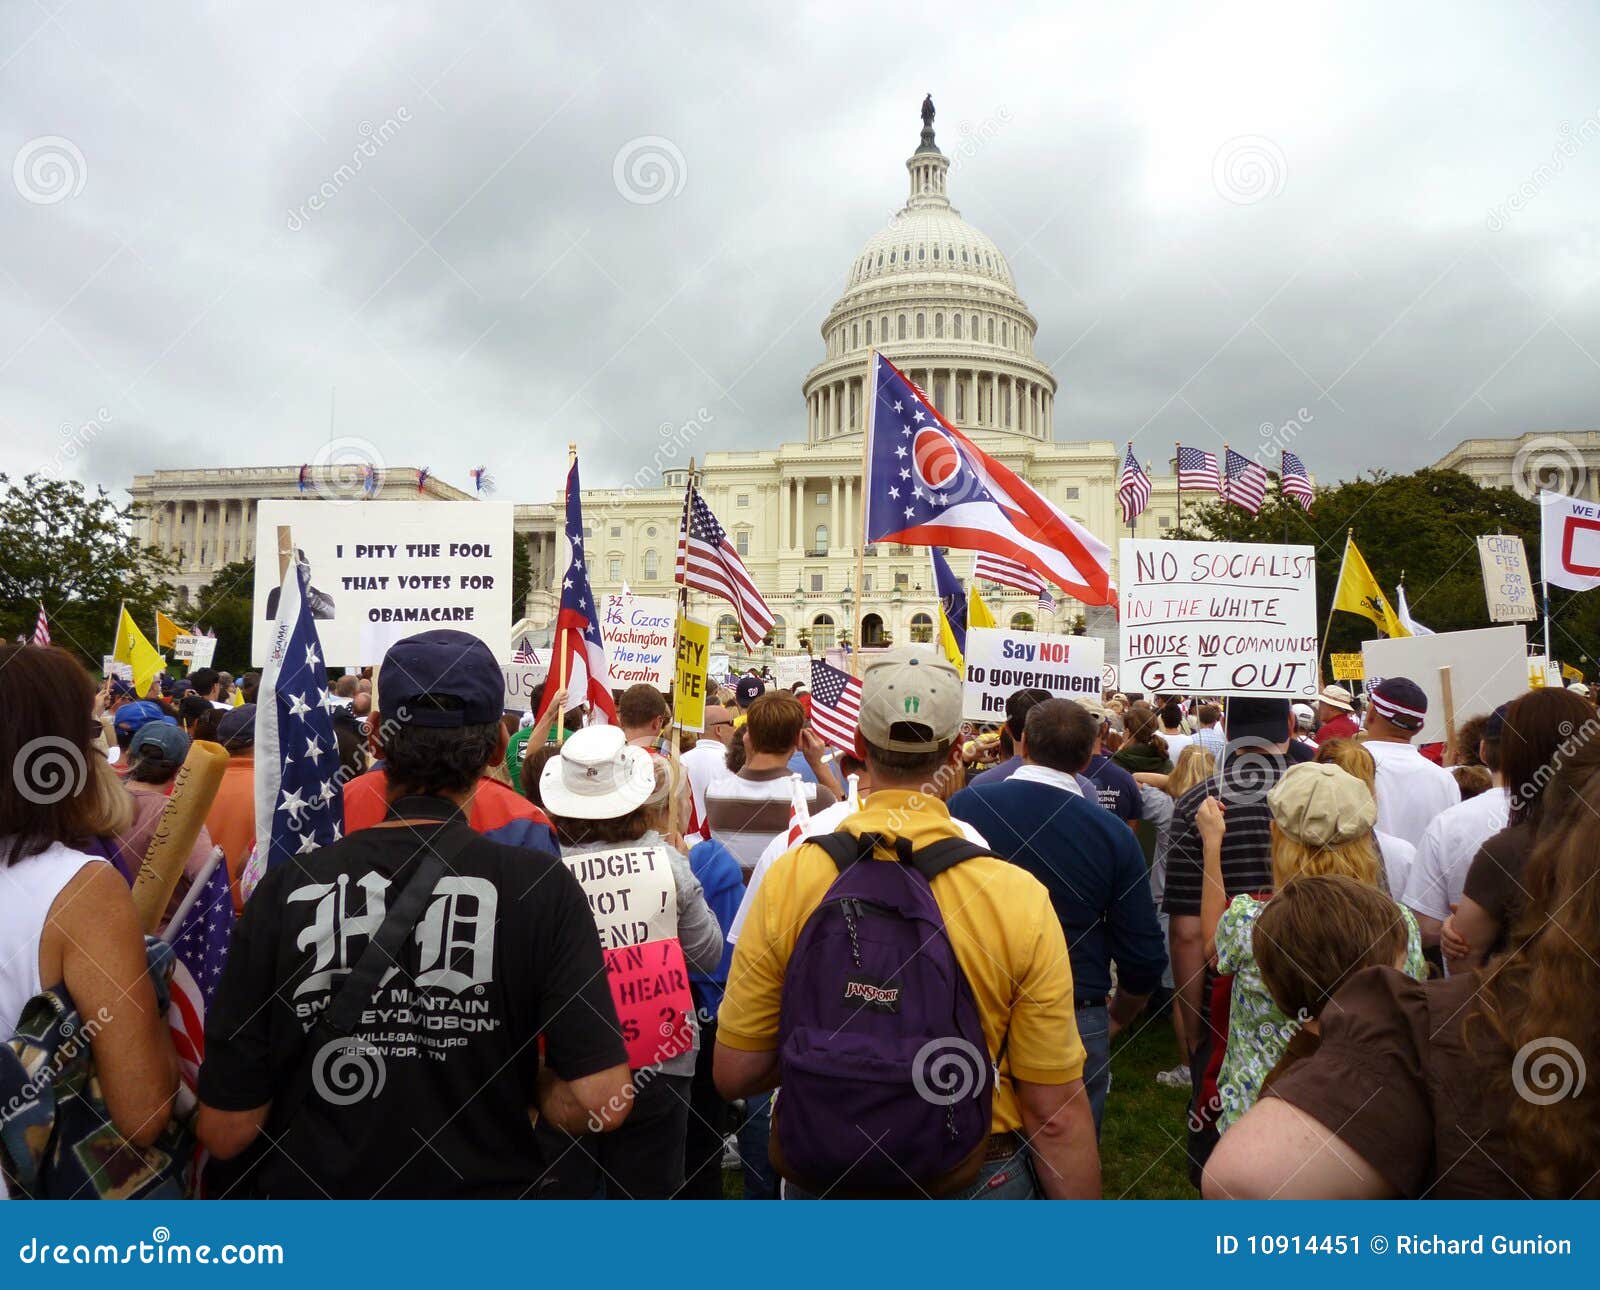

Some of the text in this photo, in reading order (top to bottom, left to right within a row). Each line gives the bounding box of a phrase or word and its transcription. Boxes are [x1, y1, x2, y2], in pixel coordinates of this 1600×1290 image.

[1572, 503, 1594, 517] WE
[336, 543, 493, 558] I PITY THE FOOL
[1495, 555, 1520, 567] EYES
[1136, 550, 1316, 583] NO SOCIALIST
[341, 575, 494, 590] THAT VOTES FOR
[1504, 573, 1522, 585] FOR
[368, 607, 475, 622] OBAMACARE
[631, 609, 671, 628] Czars
[1163, 599, 1203, 618] THE
[1209, 597, 1280, 618] WHITE
[602, 625, 668, 650] Washington
[1129, 634, 1191, 657] HOUSE
[613, 646, 662, 664] the new
[677, 634, 705, 667] ETY
[1002, 639, 1070, 664] Say NO!
[607, 663, 660, 683] Kremlin
[681, 669, 702, 698] IFE
[967, 664, 986, 683] to
[989, 669, 1101, 694] government
[1140, 660, 1218, 691] GET
[1231, 658, 1317, 696] OUT!
[981, 692, 1008, 712] he
[571, 850, 657, 884] UDGET
[598, 921, 649, 949] END
[606, 945, 644, 976] AN
[619, 970, 687, 1006] HEAR
[622, 1018, 641, 1042] S
